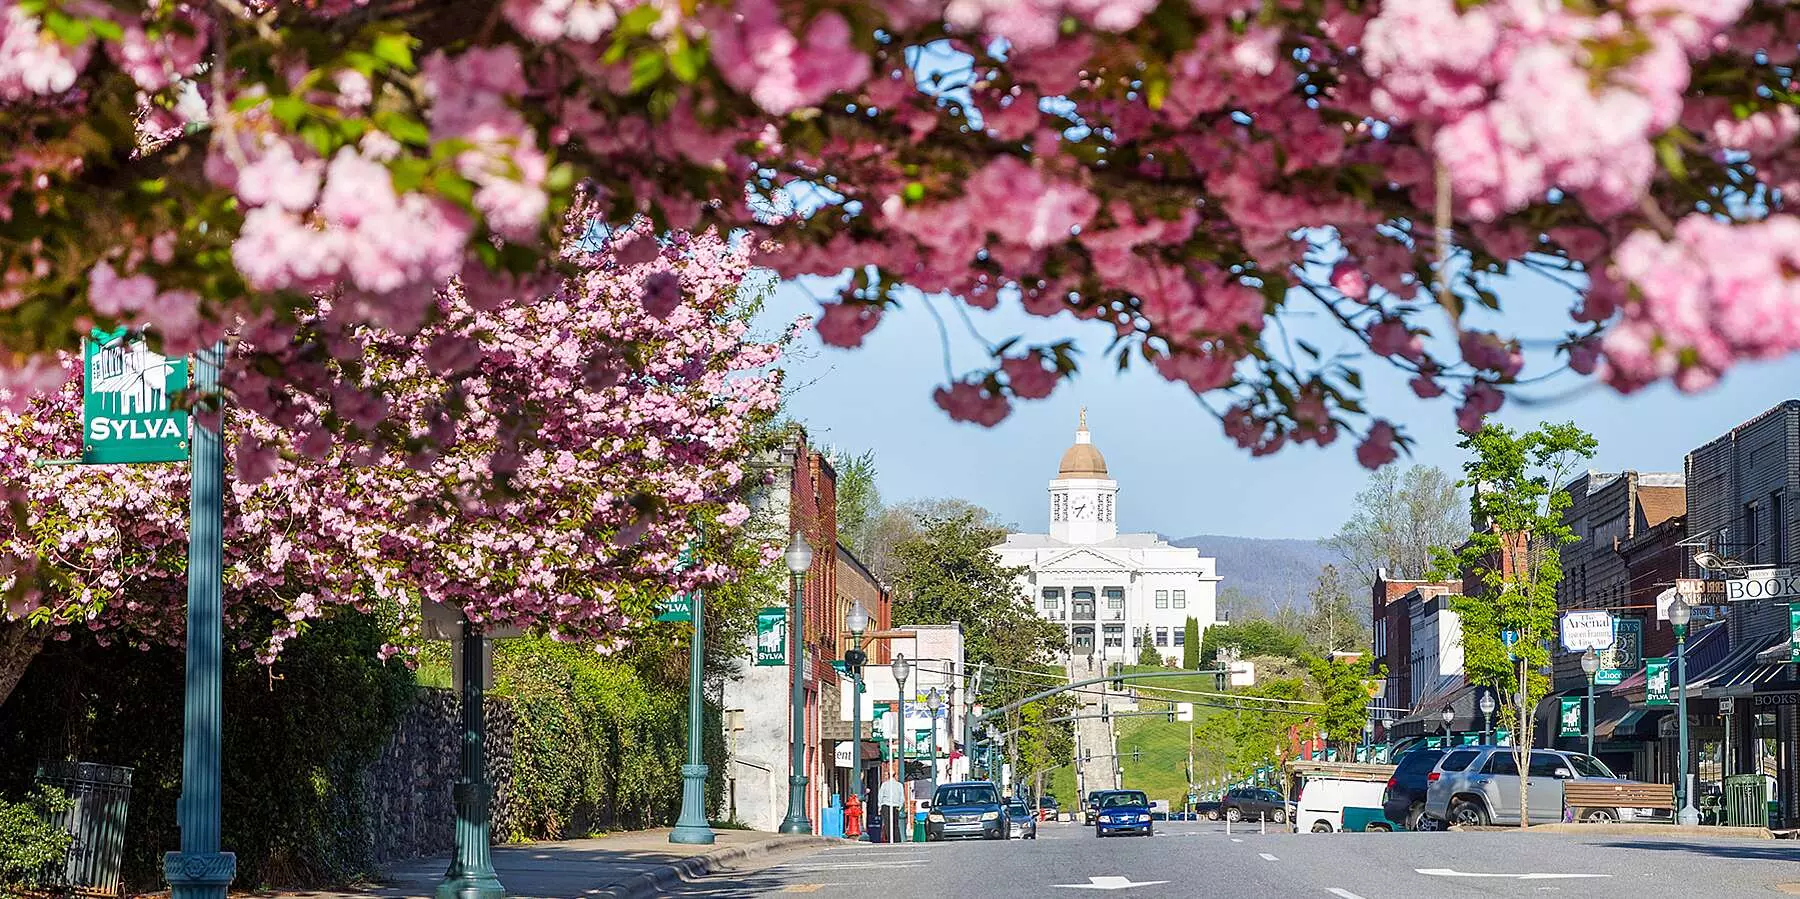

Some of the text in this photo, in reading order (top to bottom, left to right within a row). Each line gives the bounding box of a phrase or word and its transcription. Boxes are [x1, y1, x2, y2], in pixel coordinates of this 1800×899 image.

[90, 417, 181, 440] SYLVA
[1729, 577, 1800, 598] BOOK
[1566, 616, 1609, 629] Arsenal
[759, 652, 784, 660] SYLVA
[1755, 694, 1796, 705] BOOKS
